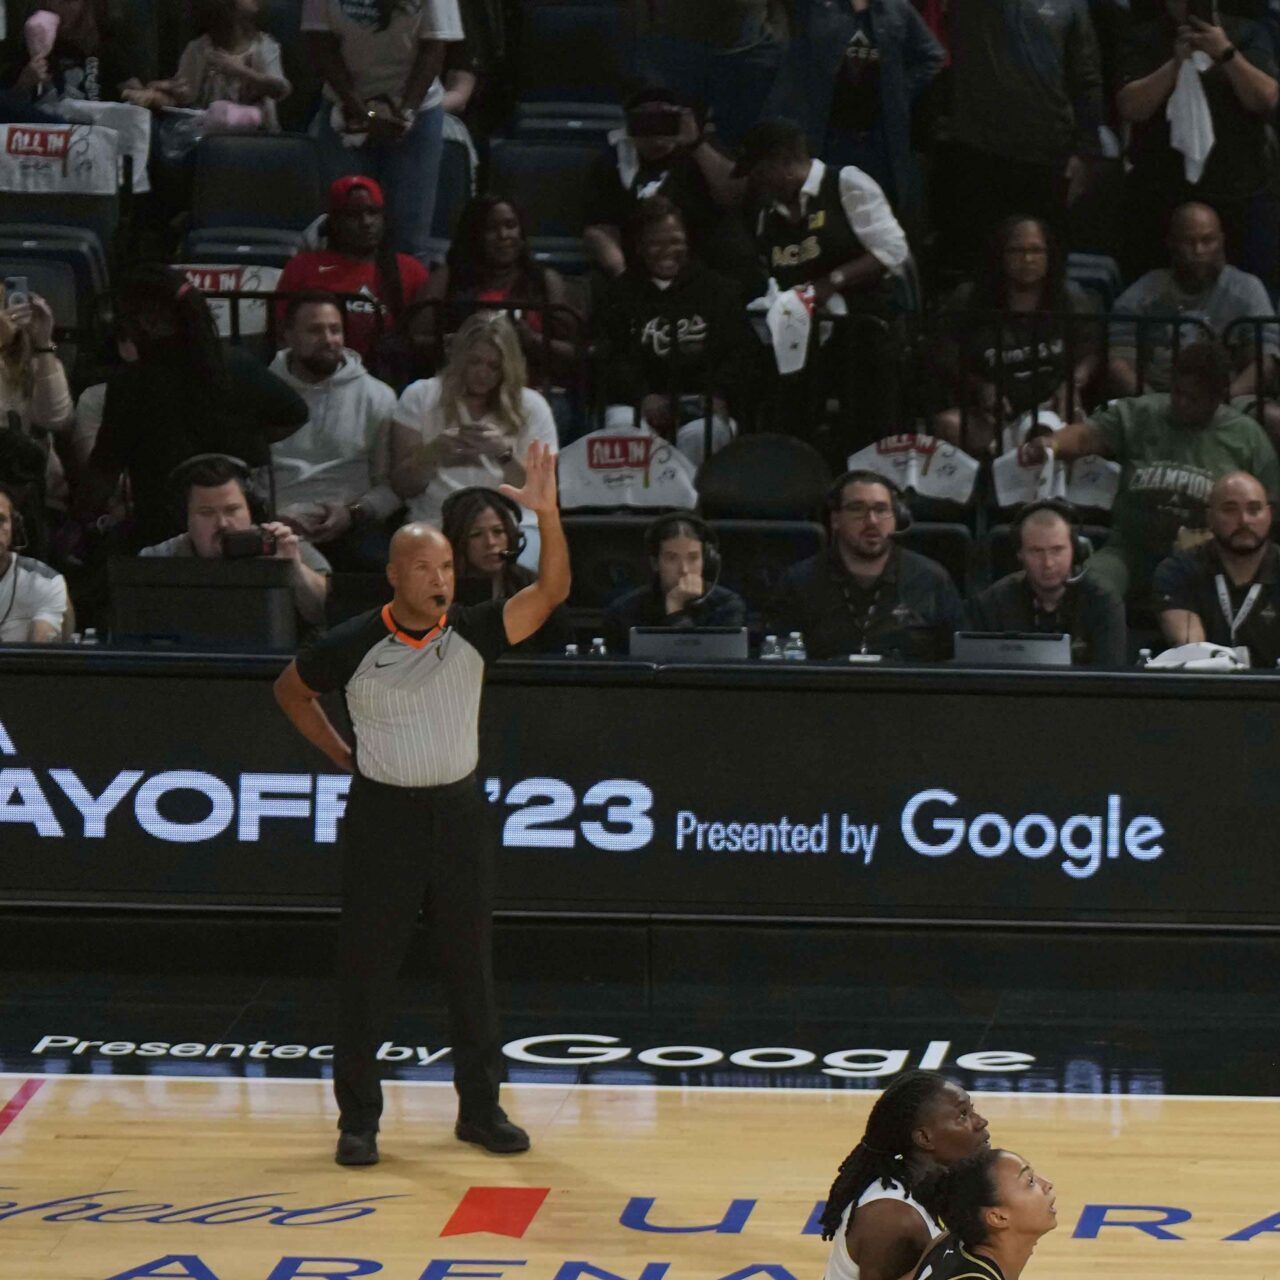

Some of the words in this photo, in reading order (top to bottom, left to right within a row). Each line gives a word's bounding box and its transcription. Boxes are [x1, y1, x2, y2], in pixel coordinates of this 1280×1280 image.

[11, 131, 43, 152] ALL
[591, 440, 626, 465] ALL
[676, 810, 829, 855] Presented
[841, 814, 880, 867] by
[901, 788, 1165, 880] Google
[375, 1041, 453, 1065] by
[502, 1034, 1038, 1078] Google
